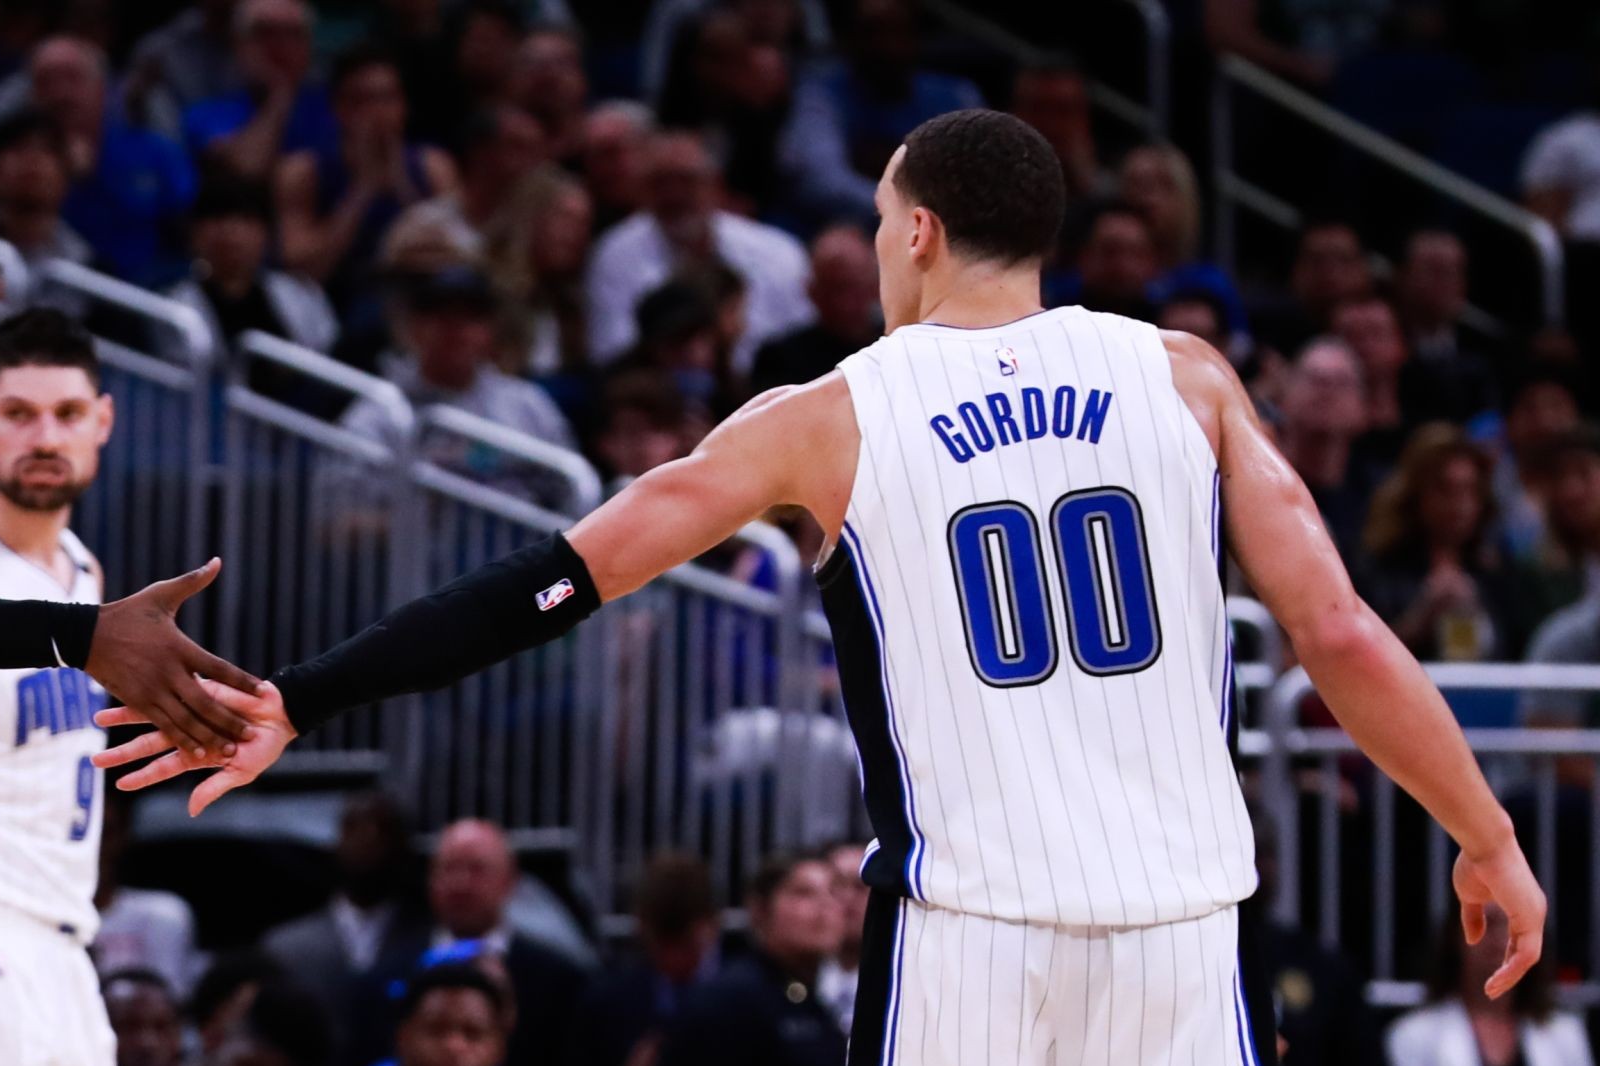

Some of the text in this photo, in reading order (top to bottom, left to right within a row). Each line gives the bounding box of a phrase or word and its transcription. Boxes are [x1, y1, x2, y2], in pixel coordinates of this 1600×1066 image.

[929, 384, 1113, 464] GORDON
[946, 485, 1163, 690] 00
[70, 755, 94, 841] 9
